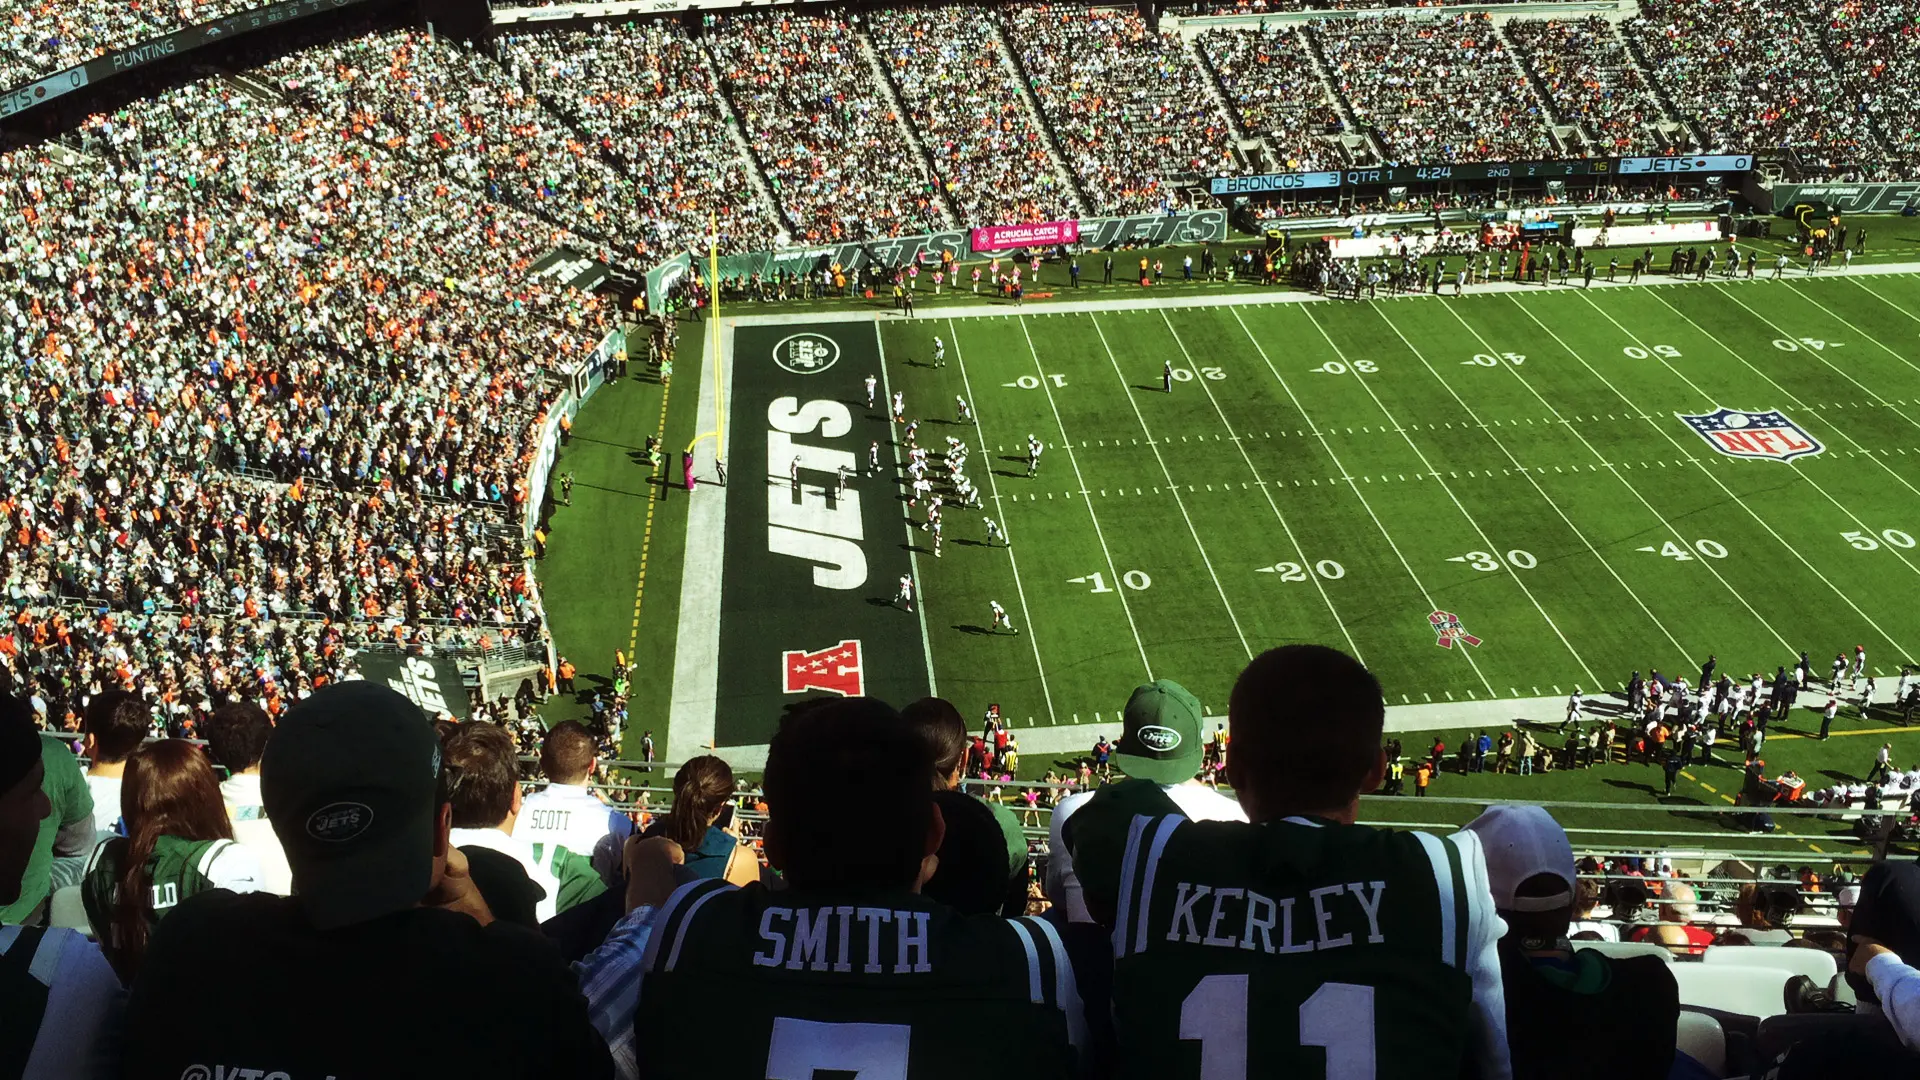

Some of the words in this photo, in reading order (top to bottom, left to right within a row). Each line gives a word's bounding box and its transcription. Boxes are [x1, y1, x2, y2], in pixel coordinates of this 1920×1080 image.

[113, 38, 175, 71] PUNTING
[70, 71, 80, 87] 0
[0, 88, 33, 116] ETS
[1416, 167, 1452, 179] 4:24
[1487, 169, 1510, 177] 2ND
[1593, 162, 1608, 171] 16
[1641, 158, 1692, 172] JETS
[1735, 159, 1747, 169] 0
[1227, 174, 1304, 191] BRONCOS
[1329, 173, 1338, 185] 3
[1347, 172, 1380, 185] QTR
[1387, 170, 1393, 180] 1
[1837, 184, 1920, 214] JE
[1001, 228, 1033, 239] CRUCIAL
[1034, 226, 1058, 237] CATCH
[1081, 211, 1223, 248] JETS
[1623, 345, 1682, 359] 50
[1322, 359, 1380, 375] 30
[1712, 429, 1811, 454] NFL
[768, 396, 868, 590] JETS
[1660, 539, 1729, 562] 40
[1839, 529, 1917, 551] 50
[1275, 559, 1346, 582] 20
[1465, 549, 1538, 572] 30
[1085, 570, 1152, 593] 10
[406, 656, 453, 721] JETS
[316, 812, 361, 831] JETS
[531, 809, 571, 830] SCOTT
[151, 881, 178, 910] LD
[1166, 881, 1386, 954] KERLEY
[753, 906, 932, 974] SMITH
[1179, 974, 1376, 1080] 11
